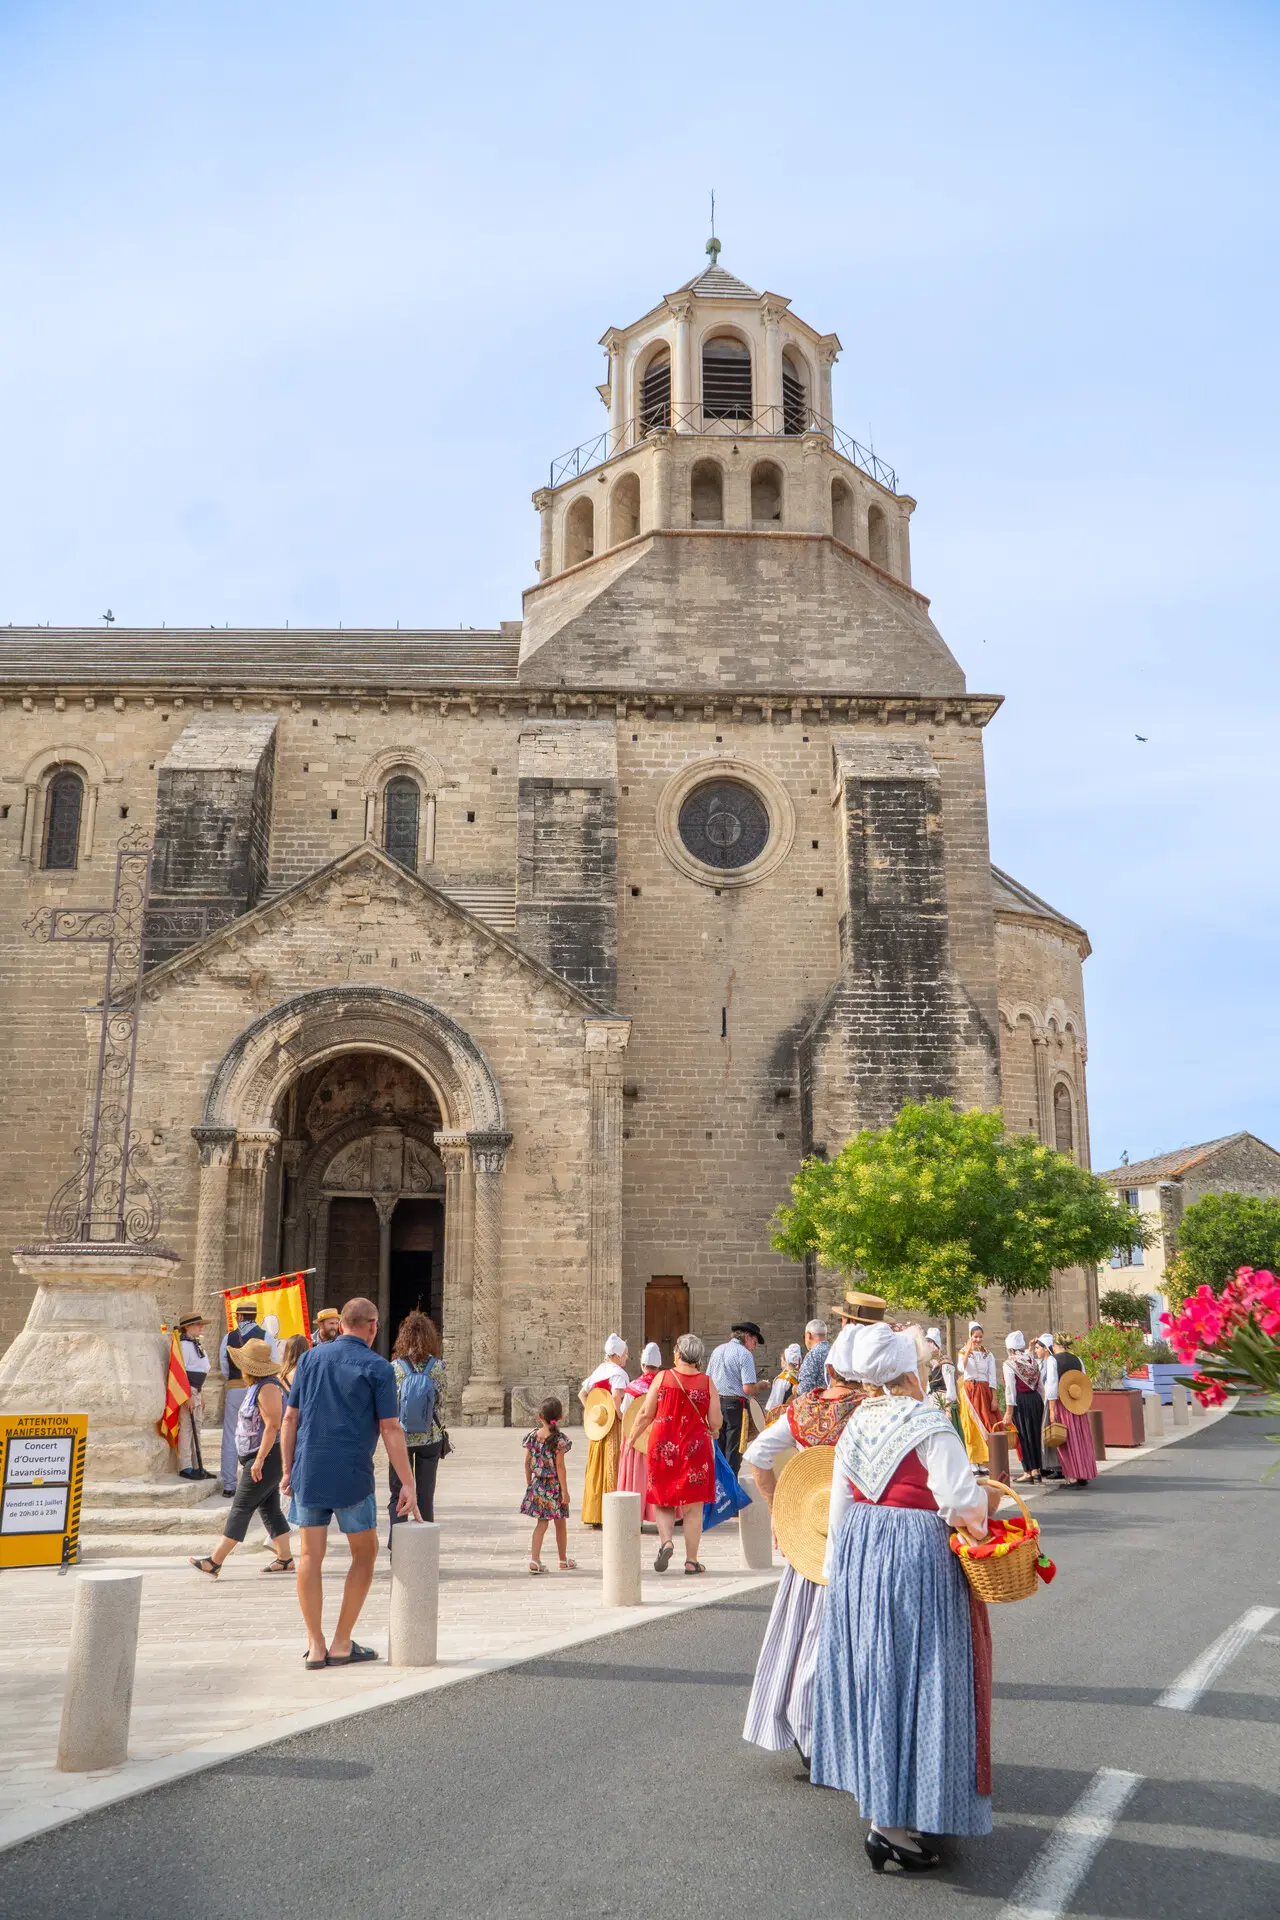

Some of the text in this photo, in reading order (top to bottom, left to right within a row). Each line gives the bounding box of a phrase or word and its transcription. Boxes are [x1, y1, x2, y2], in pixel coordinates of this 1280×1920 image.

[17, 1417, 69, 1426] ATTENTION
[5, 1427, 79, 1436] MANIFESTATION
[24, 1442, 58, 1450] Concert
[14, 1455, 66, 1463] d'Ouverture
[10, 1468, 67, 1476] Lavandissima
[6, 1500, 34, 1508] Vendredi
[44, 1499, 63, 1507] juillet
